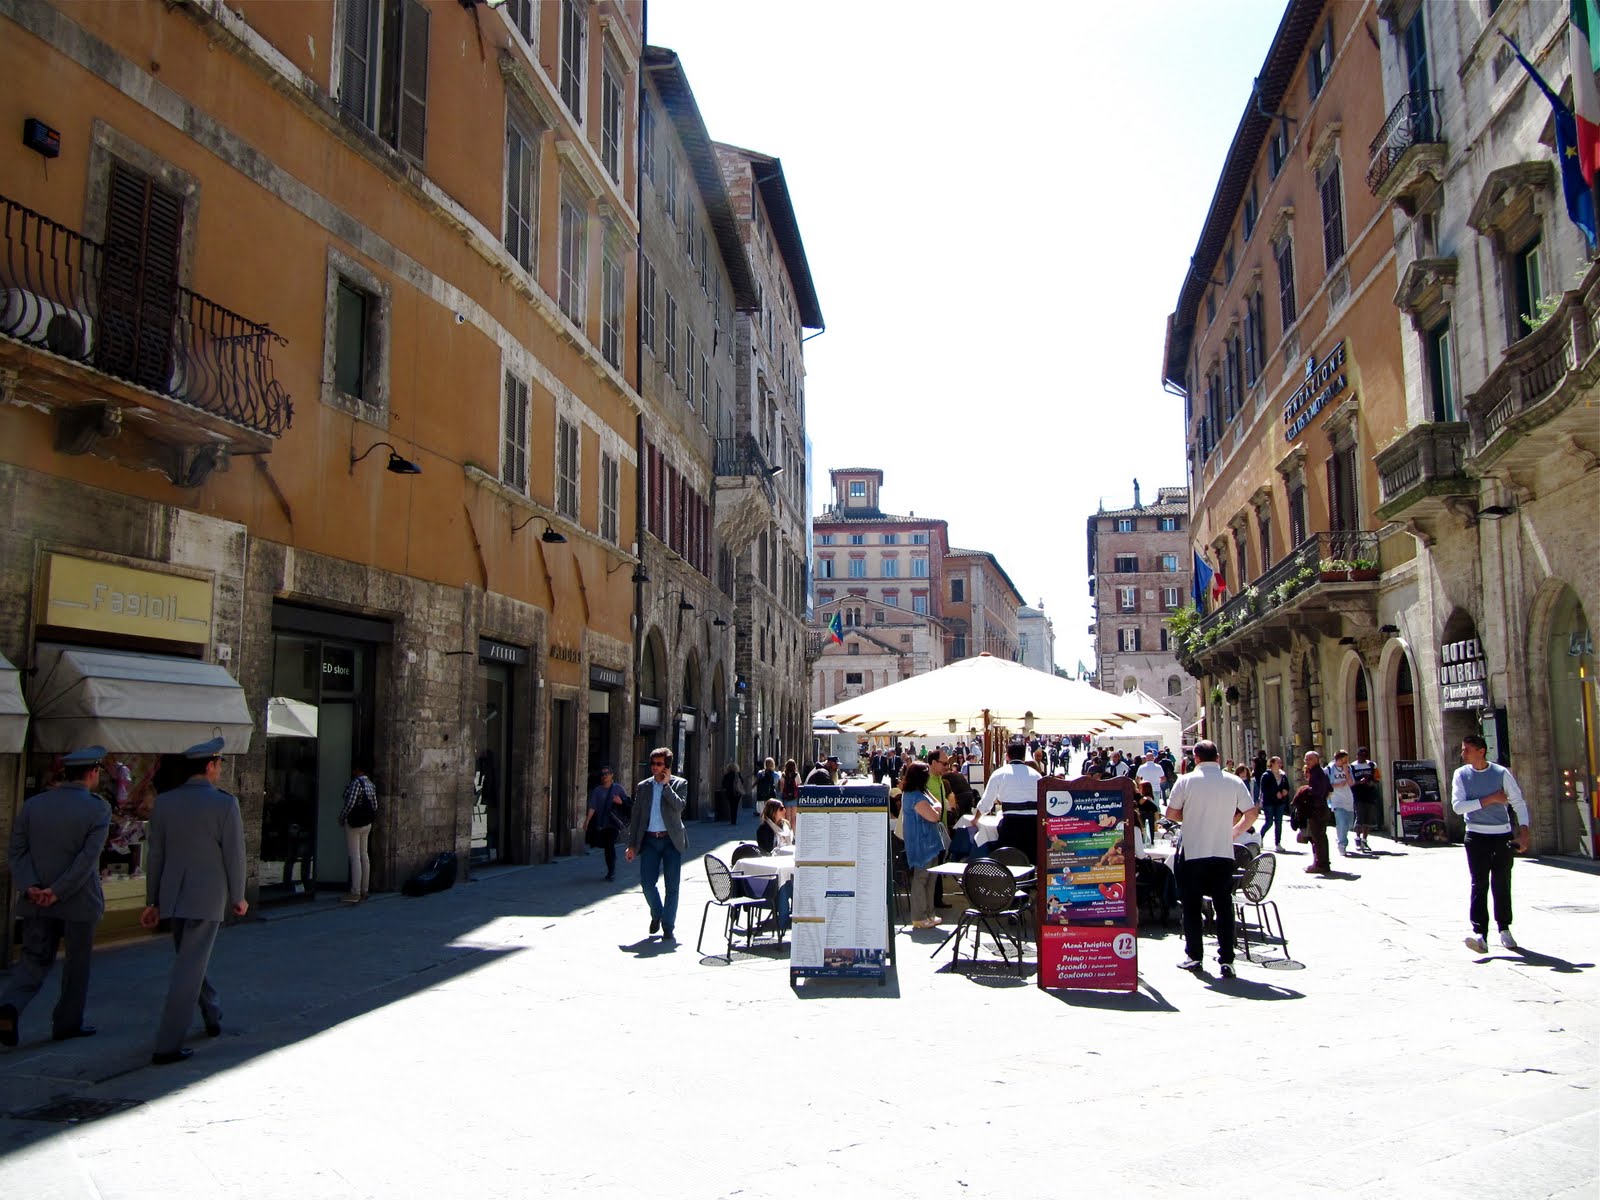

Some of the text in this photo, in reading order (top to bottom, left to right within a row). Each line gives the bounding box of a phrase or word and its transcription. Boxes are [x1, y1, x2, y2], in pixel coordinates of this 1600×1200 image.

[1284, 350, 1345, 424] FONDAZIONE
[92, 583, 177, 622] Fagioli
[1442, 638, 1483, 663] HOTEL
[322, 663, 350, 675] ED store
[1441, 660, 1486, 684] UMBRIA
[798, 795, 886, 806] ristorante pizzeria ferrari
[1049, 796, 1058, 808] 9
[1095, 802, 1122, 810] Bambini
[1083, 941, 1112, 949] Turistico
[1118, 937, 1133, 950] 12
[1062, 954, 1085, 962] Primo
[1056, 963, 1087, 971] Secondo
